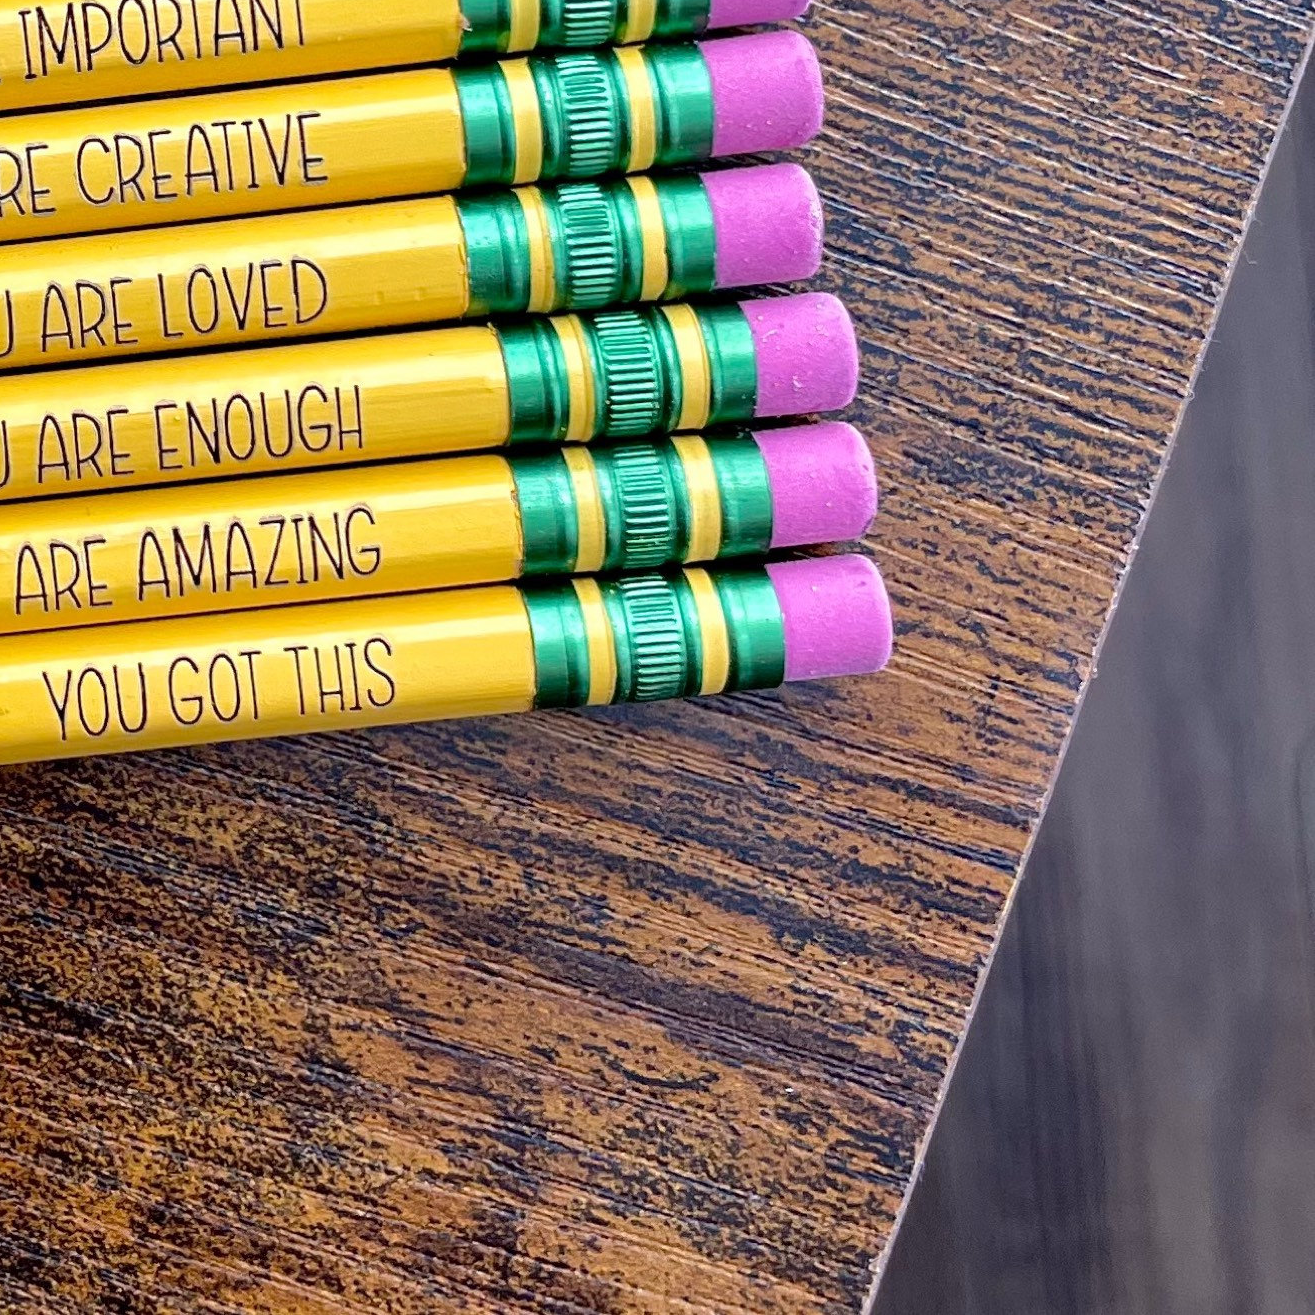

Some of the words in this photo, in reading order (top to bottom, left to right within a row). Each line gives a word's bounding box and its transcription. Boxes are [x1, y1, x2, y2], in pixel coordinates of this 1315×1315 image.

[76, 113, 329, 206] CREATIVE
[41, 278, 140, 354] ARE
[157, 258, 329, 339] LOVED
[37, 408, 136, 485] ARE
[154, 384, 364, 472] ENOUGH
[15, 538, 114, 616] ARE
[138, 505, 382, 603] AMAZING
[42, 662, 149, 742] YOU
[168, 650, 263, 727] GOT
[283, 637, 396, 717] THIS
